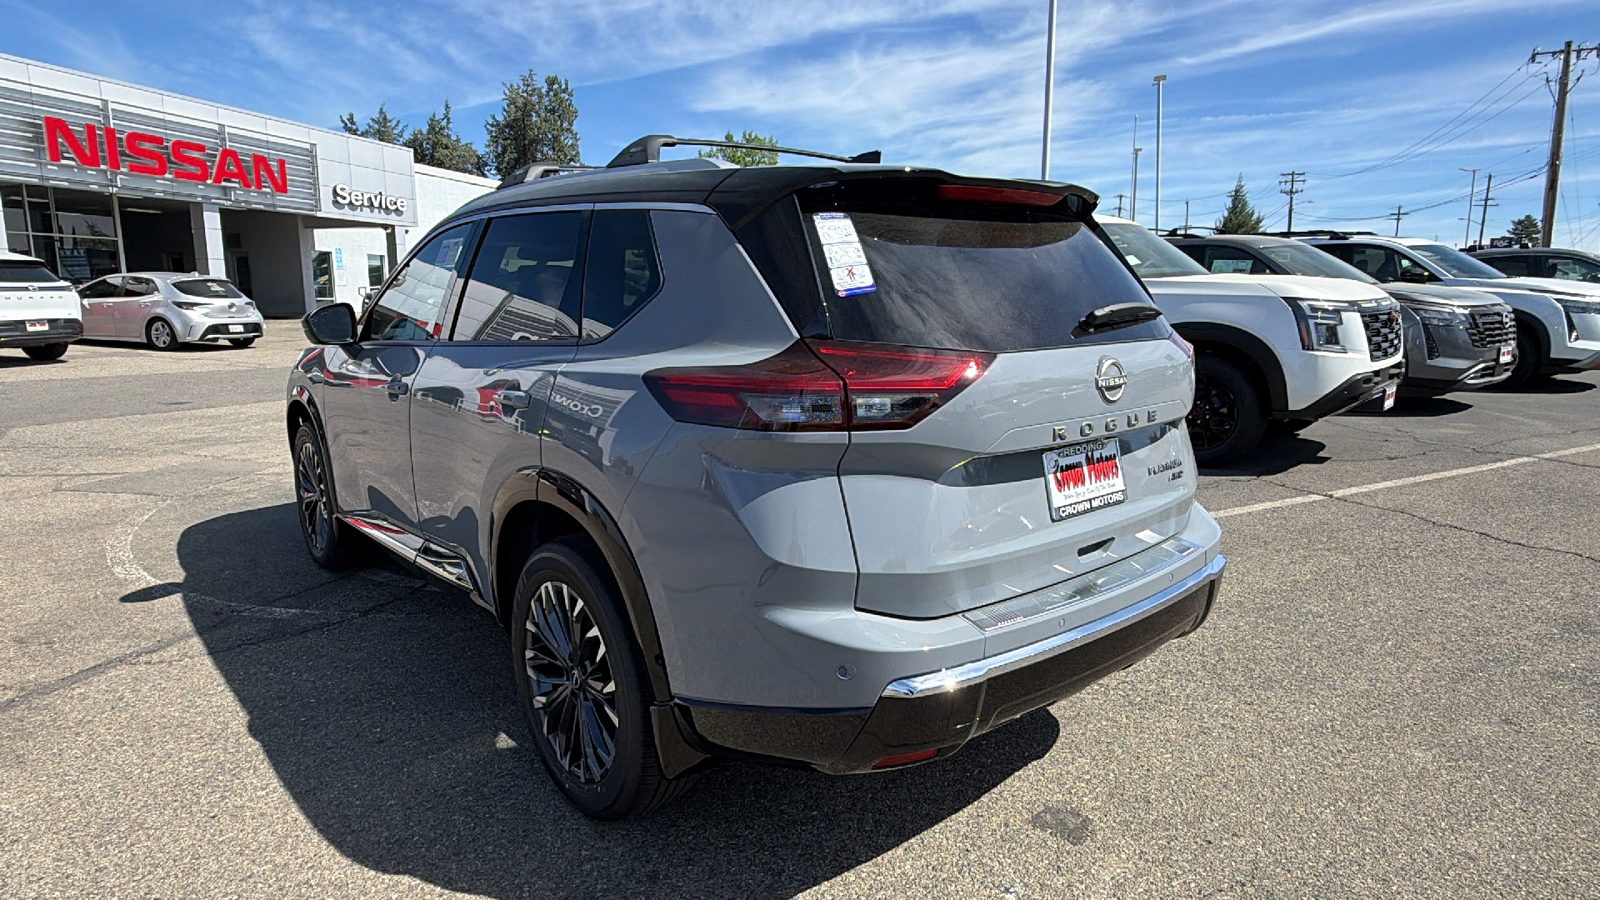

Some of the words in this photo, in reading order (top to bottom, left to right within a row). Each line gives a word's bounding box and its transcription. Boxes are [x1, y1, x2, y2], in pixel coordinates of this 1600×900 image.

[43, 115, 289, 194] NISSAN
[334, 183, 408, 212] Service
[1098, 377, 1127, 387] NISSAN
[1052, 409, 1158, 442] ROGUE
[1060, 500, 1091, 517] CROWN
[1091, 491, 1124, 508] MOTORS
